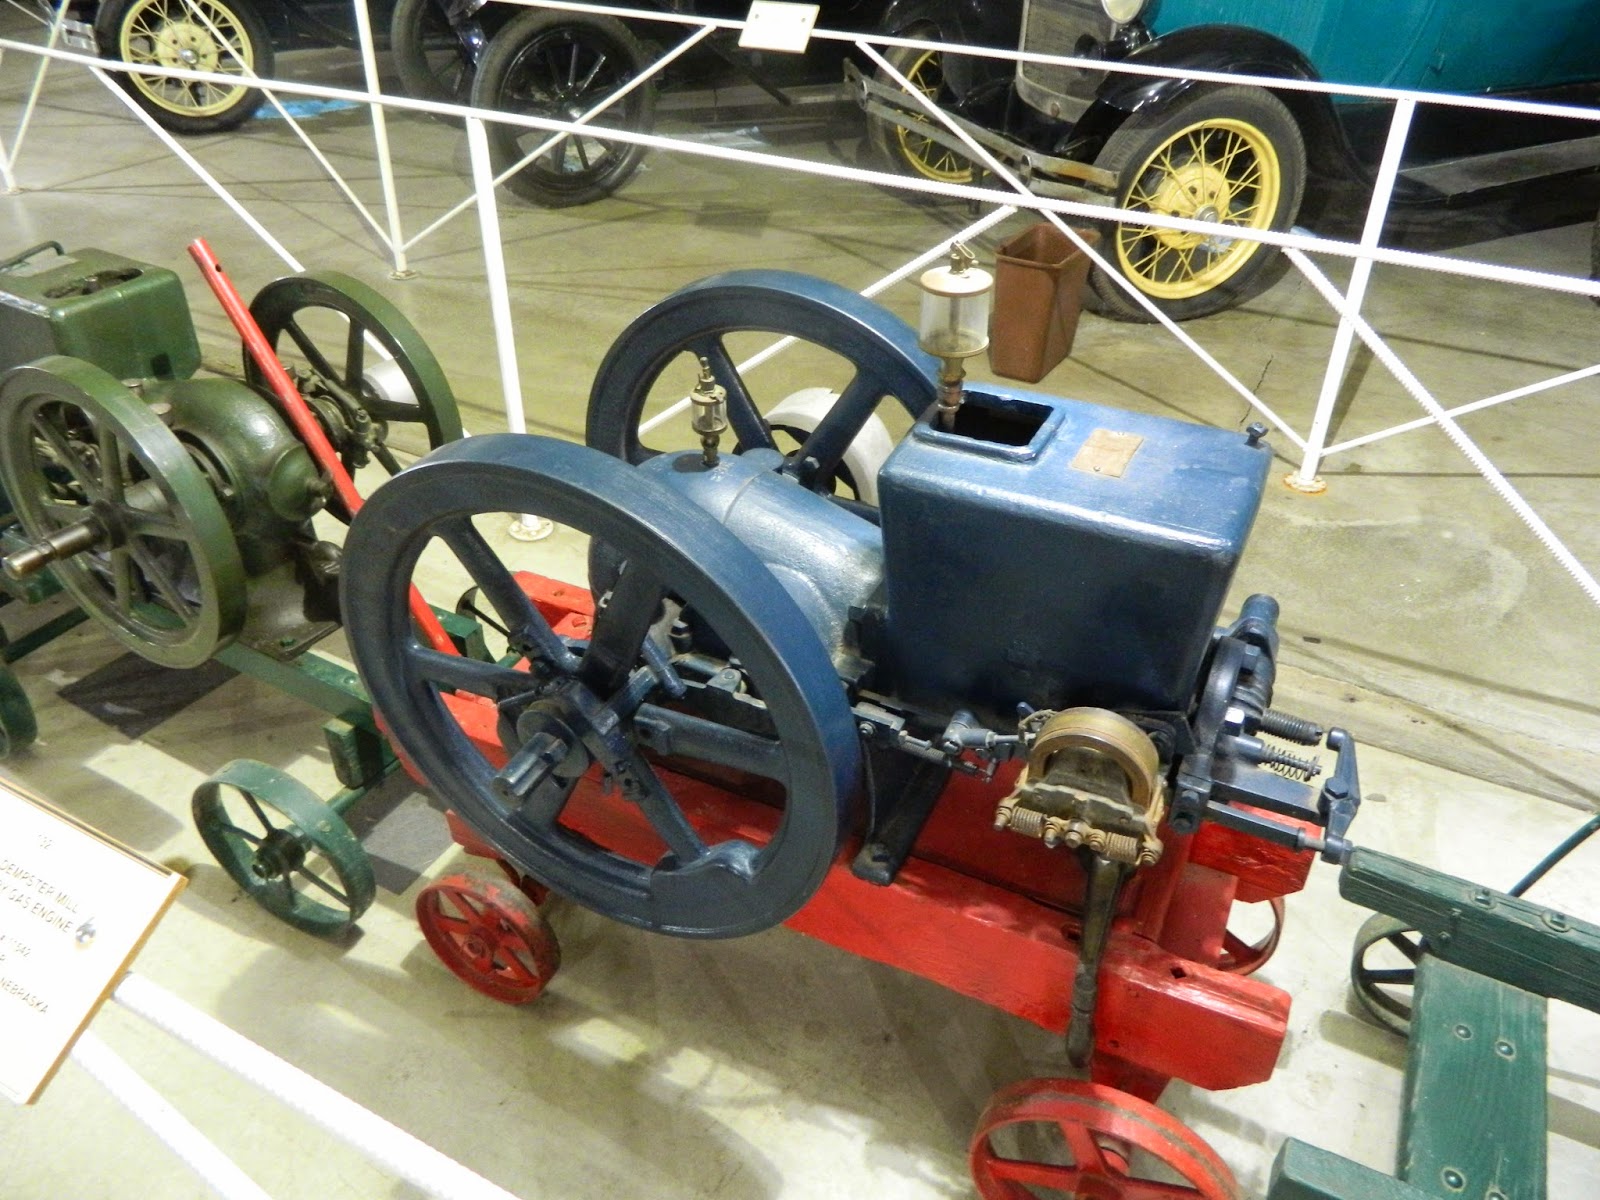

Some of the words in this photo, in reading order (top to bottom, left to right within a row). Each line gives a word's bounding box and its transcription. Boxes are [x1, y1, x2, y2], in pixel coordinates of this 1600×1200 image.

[0, 859, 55, 896] DEMPSTER
[55, 891, 79, 914] MILL
[8, 888, 31, 909] GAS
[31, 902, 74, 933] ENGINE
[0, 977, 49, 1014] NEBRASKA
